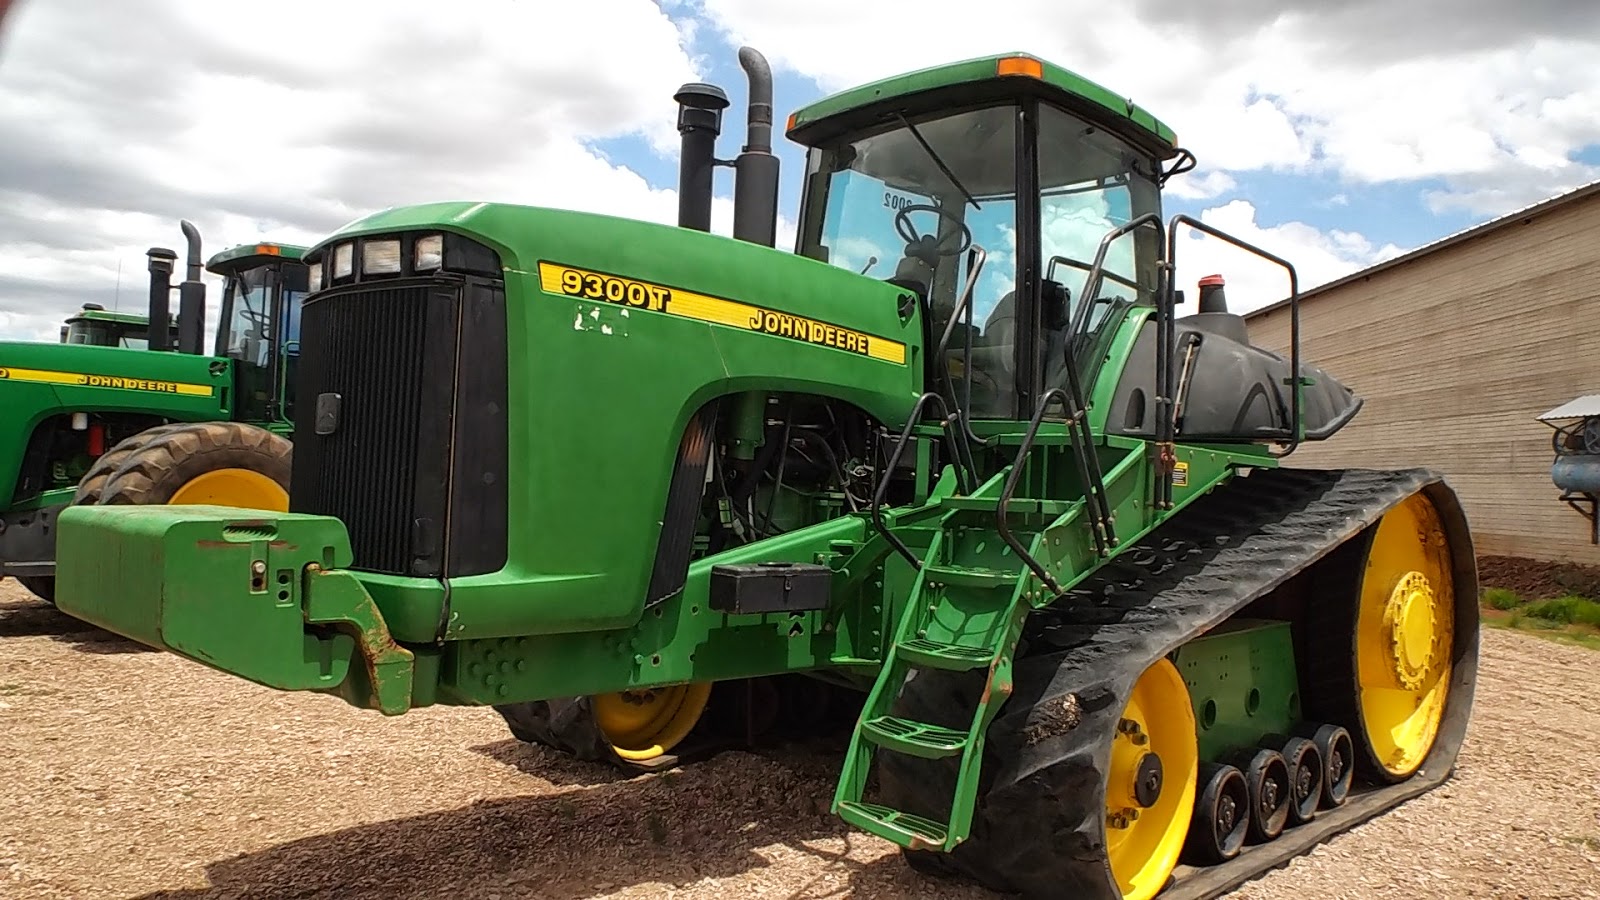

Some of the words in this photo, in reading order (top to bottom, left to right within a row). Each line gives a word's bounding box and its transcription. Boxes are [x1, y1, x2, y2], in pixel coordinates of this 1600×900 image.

[562, 269, 671, 311] 9300T
[750, 310, 809, 340] JOHN
[812, 323, 869, 353] DEERE
[78, 374, 124, 388] JOHN
[125, 379, 177, 393] DEERE
